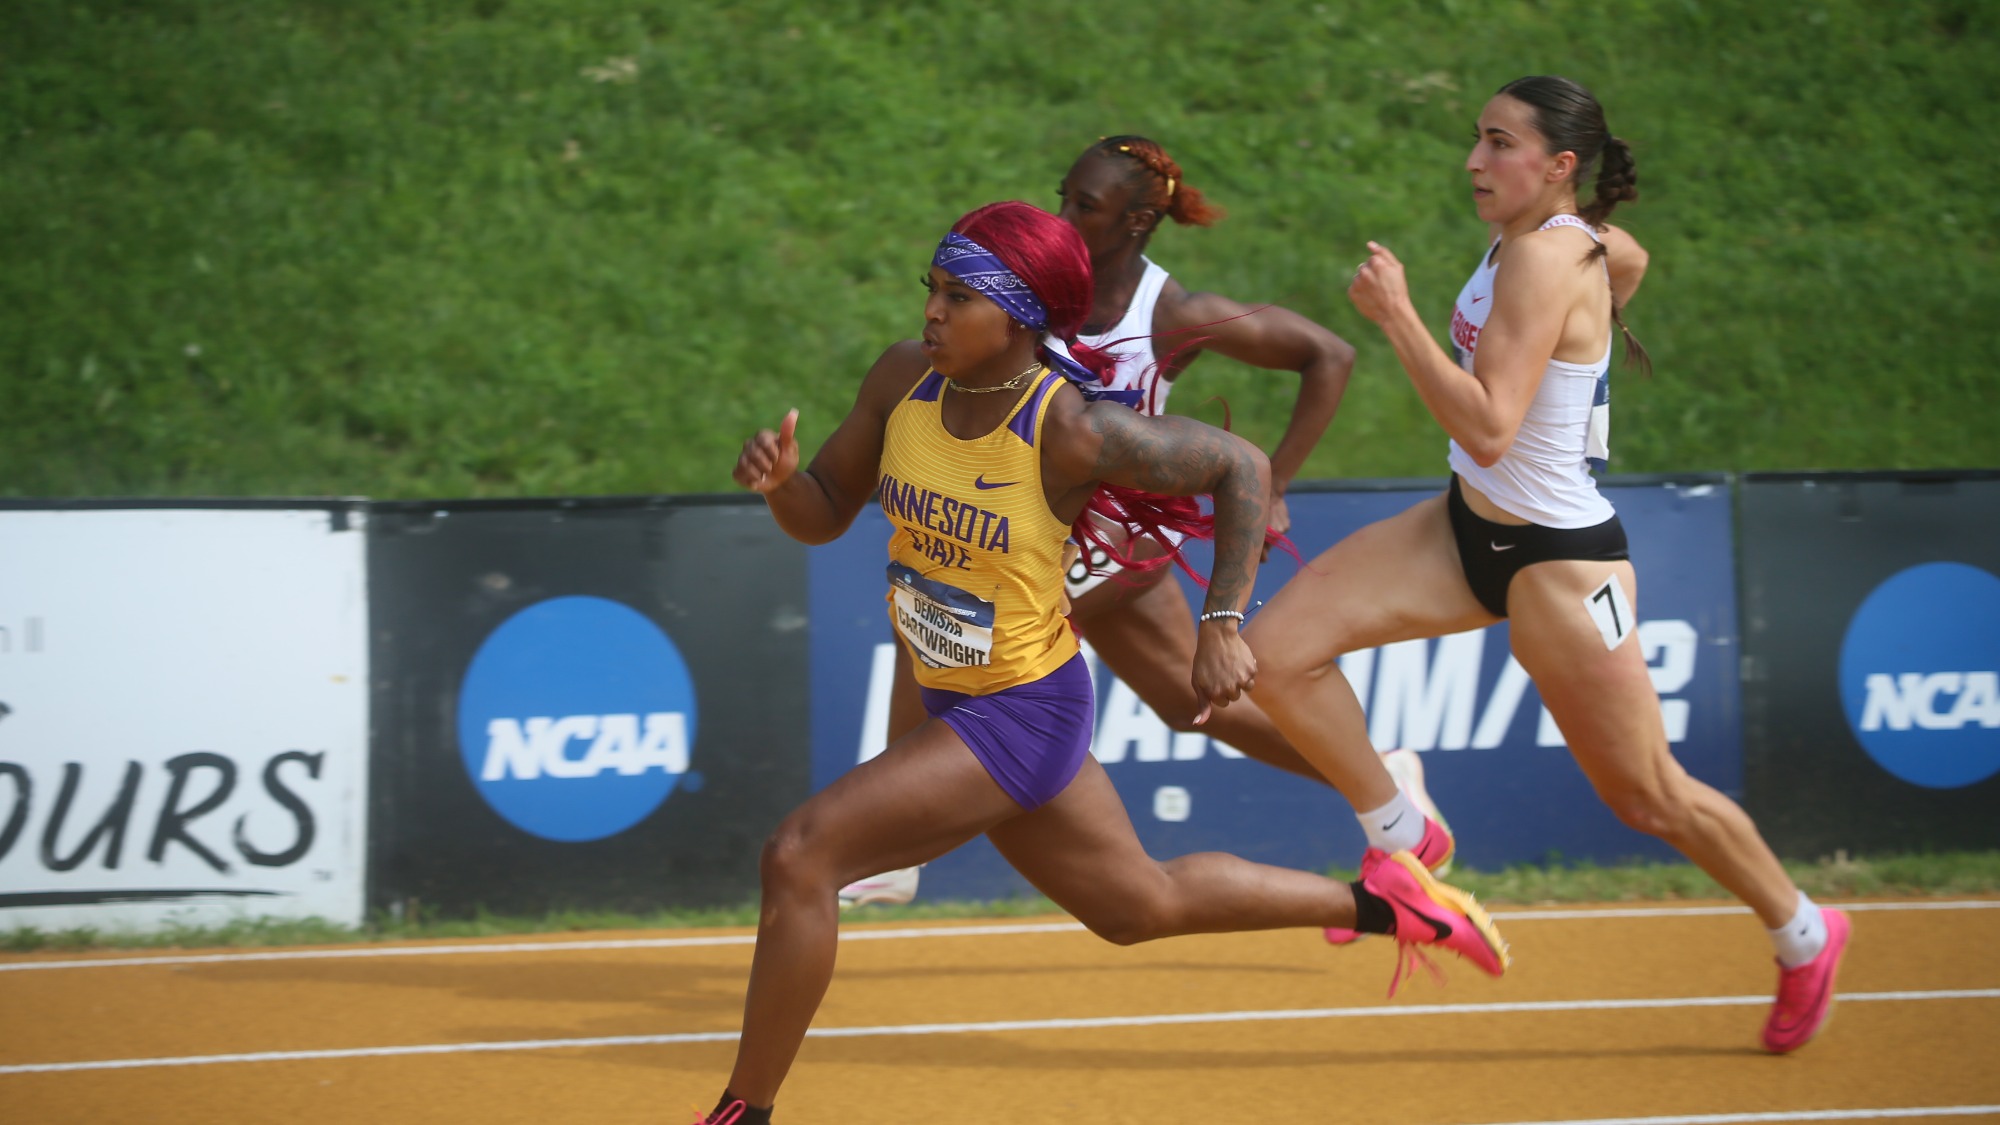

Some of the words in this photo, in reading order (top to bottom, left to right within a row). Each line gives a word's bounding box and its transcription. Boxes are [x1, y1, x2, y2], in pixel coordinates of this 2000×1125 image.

[898, 606, 985, 666] CARTWRIGHT
[914, 597, 963, 637] DENISHA
[1592, 583, 1622, 639] 7
[1859, 670, 2000, 732] NCA
[481, 711, 690, 781] NCAA
